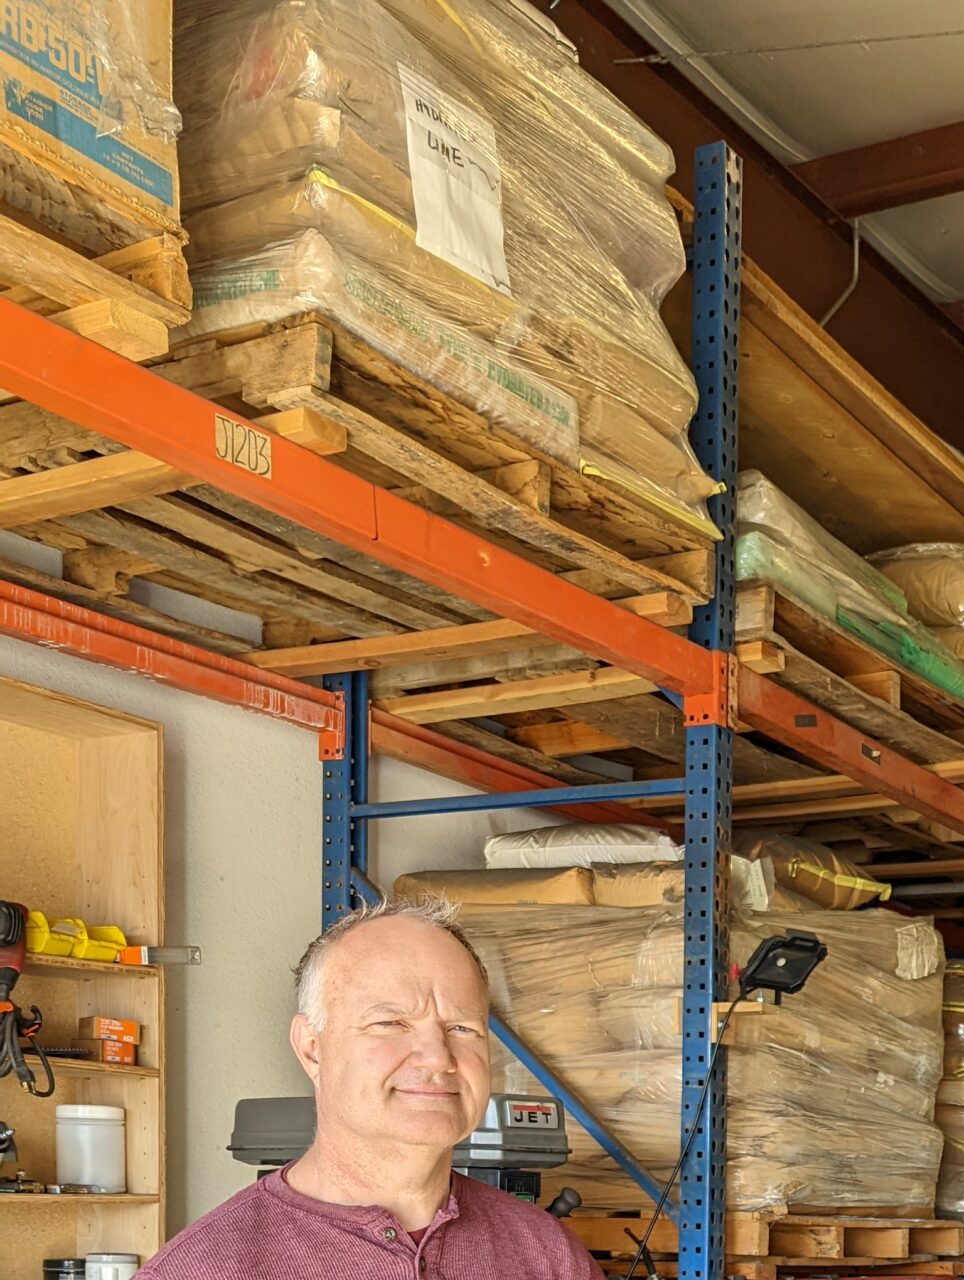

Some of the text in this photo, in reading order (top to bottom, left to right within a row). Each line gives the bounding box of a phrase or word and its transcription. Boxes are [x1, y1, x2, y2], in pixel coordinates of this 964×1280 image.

[427, 130, 465, 168] LIME
[215, 415, 270, 475] J1203
[513, 1110, 552, 1124] JET
